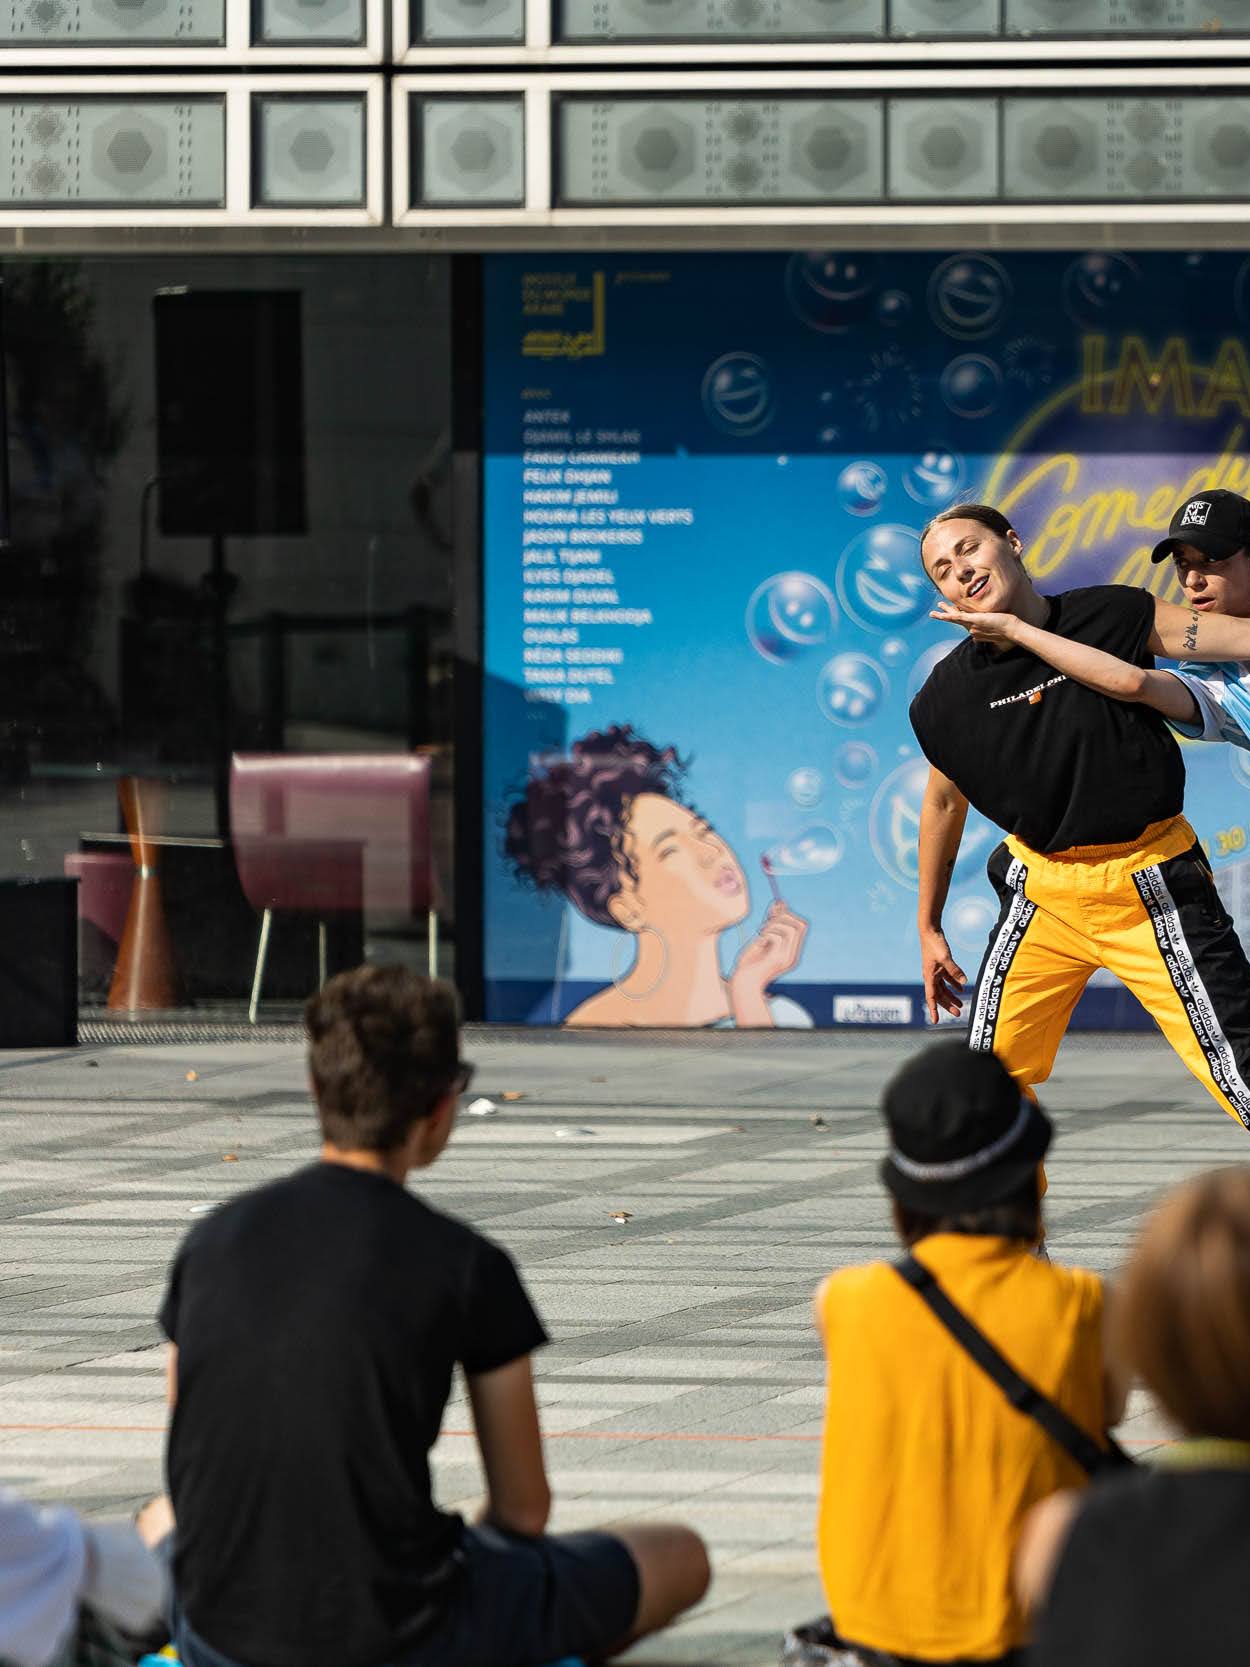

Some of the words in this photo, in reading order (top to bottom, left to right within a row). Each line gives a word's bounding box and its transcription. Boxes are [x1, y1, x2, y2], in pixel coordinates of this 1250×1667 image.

[989, 674, 1067, 709] PHILADELPHI
[978, 987, 989, 1020] adidas
[988, 987, 1001, 1020] adidas
[999, 941, 1017, 971] adidas
[1150, 906, 1166, 938] adidas
[1165, 954, 1183, 988] adidas
[1186, 1002, 1204, 1036] adidas
[1207, 1051, 1222, 1081] adidas
[1229, 1096, 1250, 1126] adidas
[1162, 902, 1176, 934] adidas
[1176, 949, 1194, 983] adidas
[1197, 998, 1215, 1032] adidas
[1217, 1046, 1231, 1076] adidas
